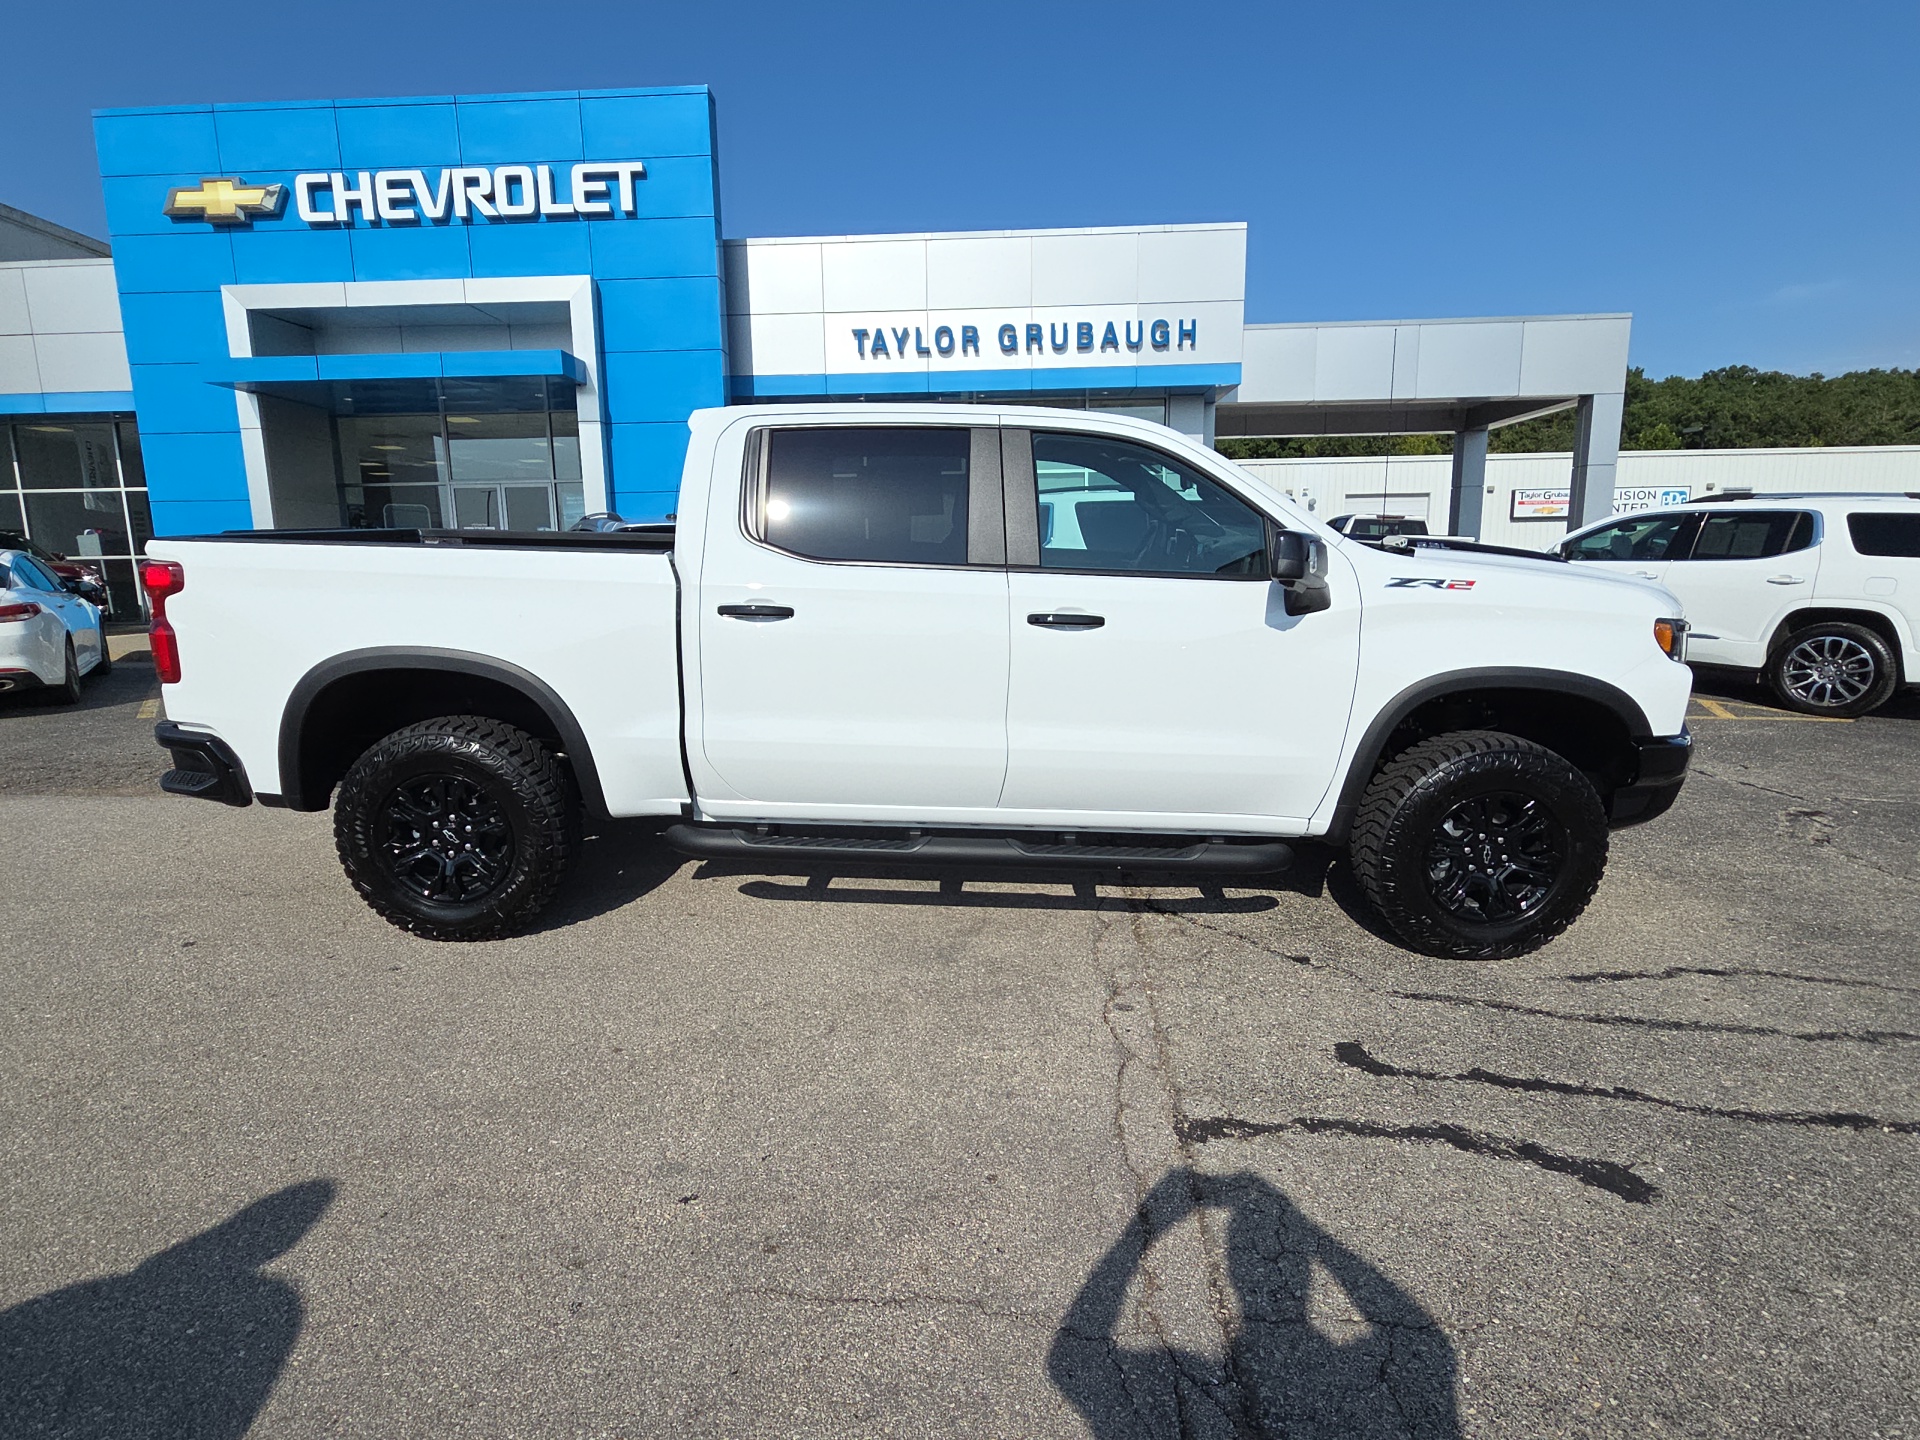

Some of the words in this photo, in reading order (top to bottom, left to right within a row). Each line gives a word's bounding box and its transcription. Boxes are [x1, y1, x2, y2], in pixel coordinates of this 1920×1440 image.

[294, 161, 644, 223] CHEVROLET
[852, 325, 980, 356] TAYLOR
[999, 319, 1197, 353] GRUBAUGH
[1518, 491, 1543, 500] Taylor
[1543, 491, 1569, 500] Gruba
[1613, 490, 1657, 501] ISION
[1384, 577, 1476, 590] ZR2
